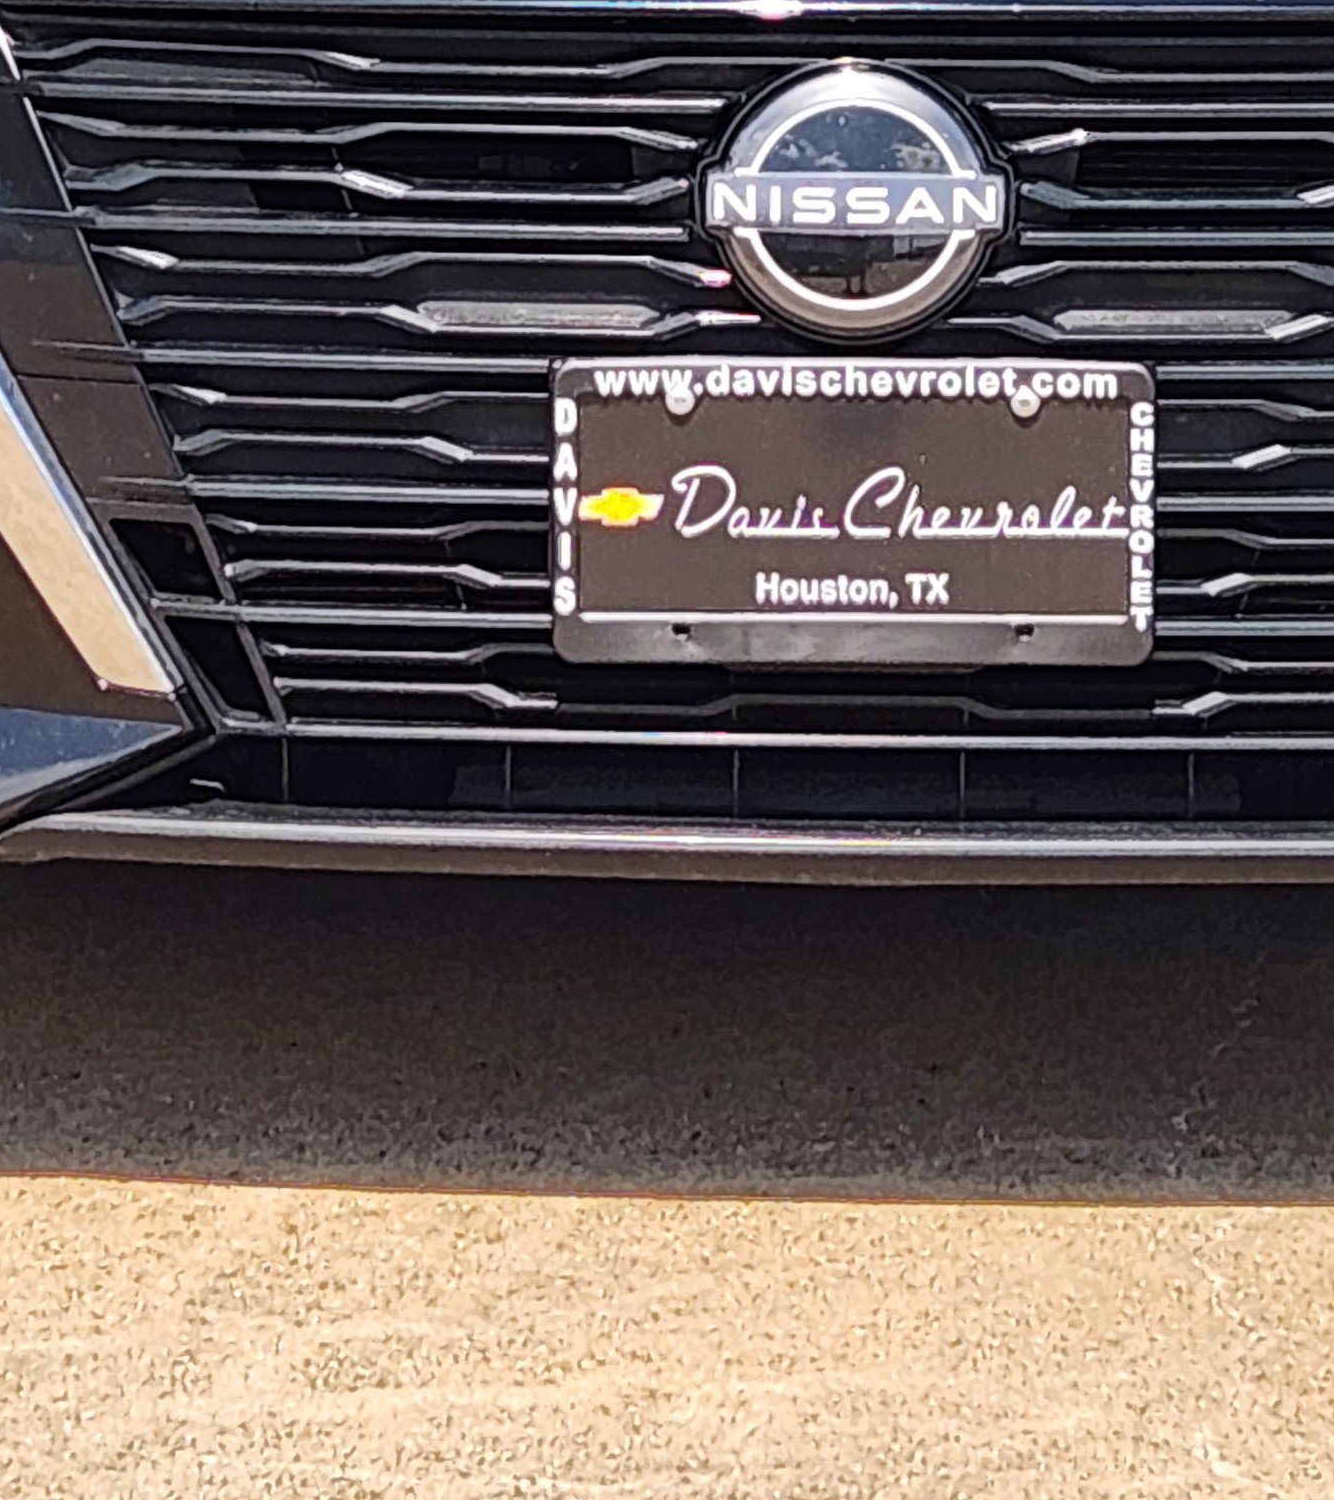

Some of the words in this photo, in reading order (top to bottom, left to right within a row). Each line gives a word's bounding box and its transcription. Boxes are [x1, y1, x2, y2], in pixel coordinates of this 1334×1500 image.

[711, 182, 999, 227] NISSAN
[593, 364, 1118, 399] www.davischevrolet.com
[553, 397, 579, 616] DAVIS
[671, 465, 840, 538] Davis
[843, 466, 1129, 539] Chevrolet
[1128, 401, 1156, 634] CHEVROLET
[755, 571, 898, 609] Houston,
[904, 572, 950, 605] TX
